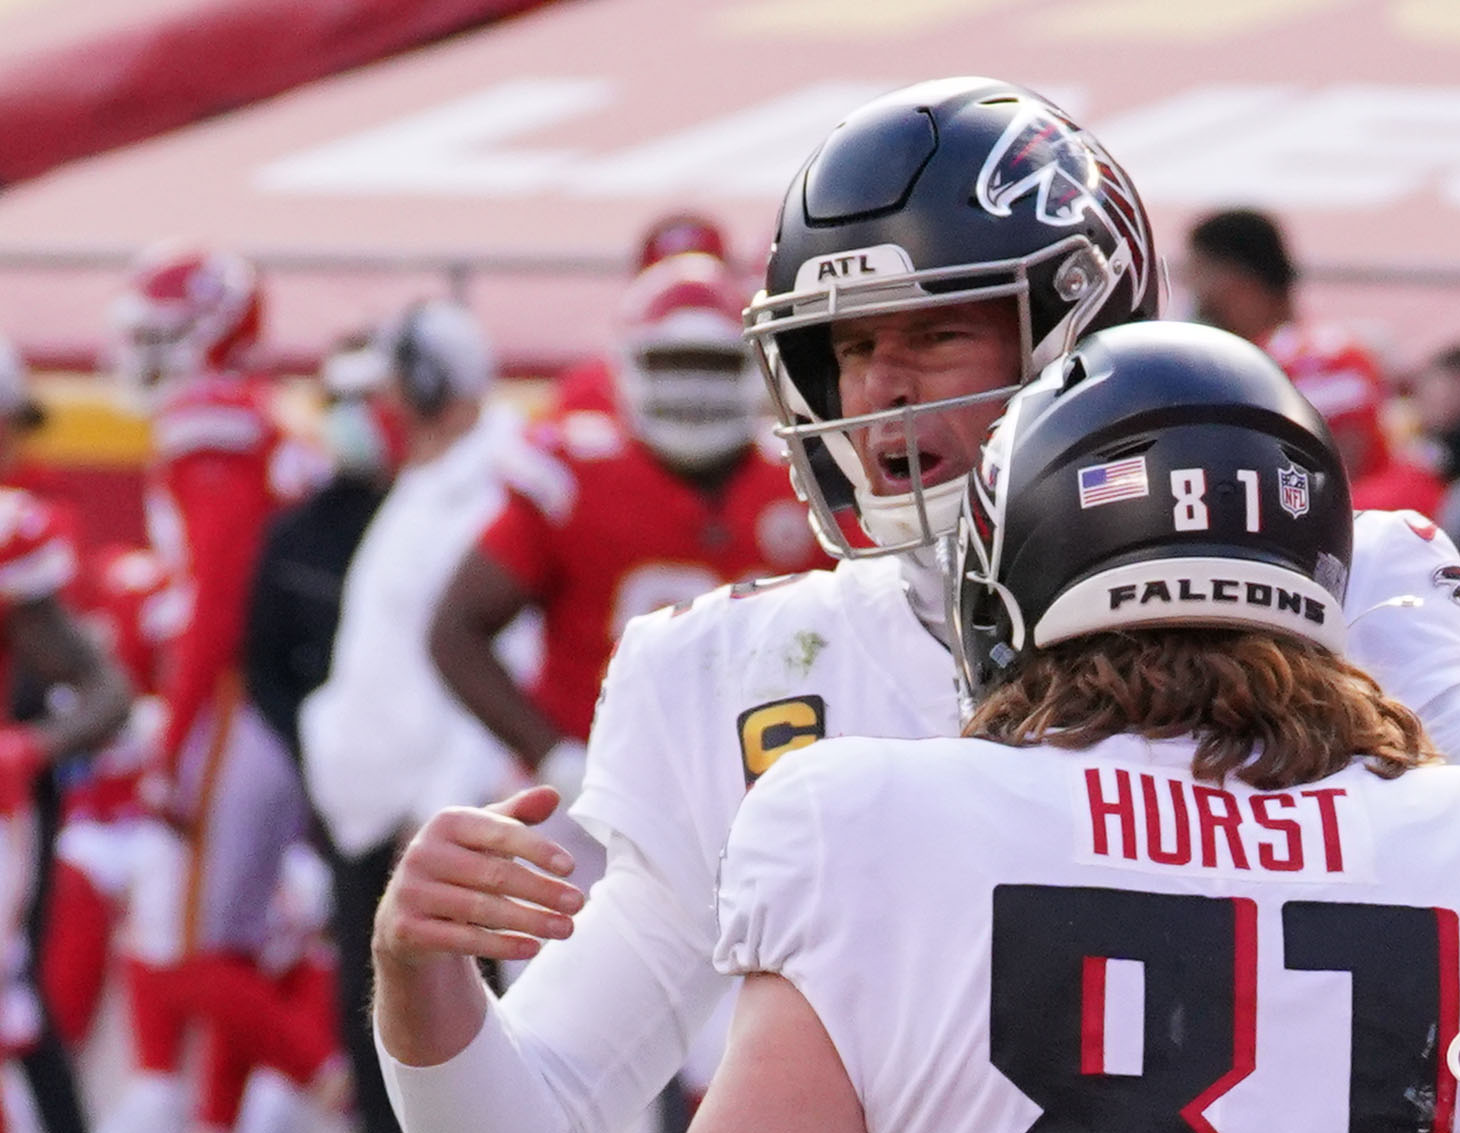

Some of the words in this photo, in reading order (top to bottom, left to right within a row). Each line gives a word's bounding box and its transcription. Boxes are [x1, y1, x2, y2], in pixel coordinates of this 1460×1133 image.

[818, 254, 875, 281] ATL
[1170, 468, 1262, 532] 81
[1283, 486, 1306, 508] NFL
[1107, 578, 1326, 625] FALCONS
[742, 699, 818, 776] C
[1084, 768, 1348, 874] HURST
